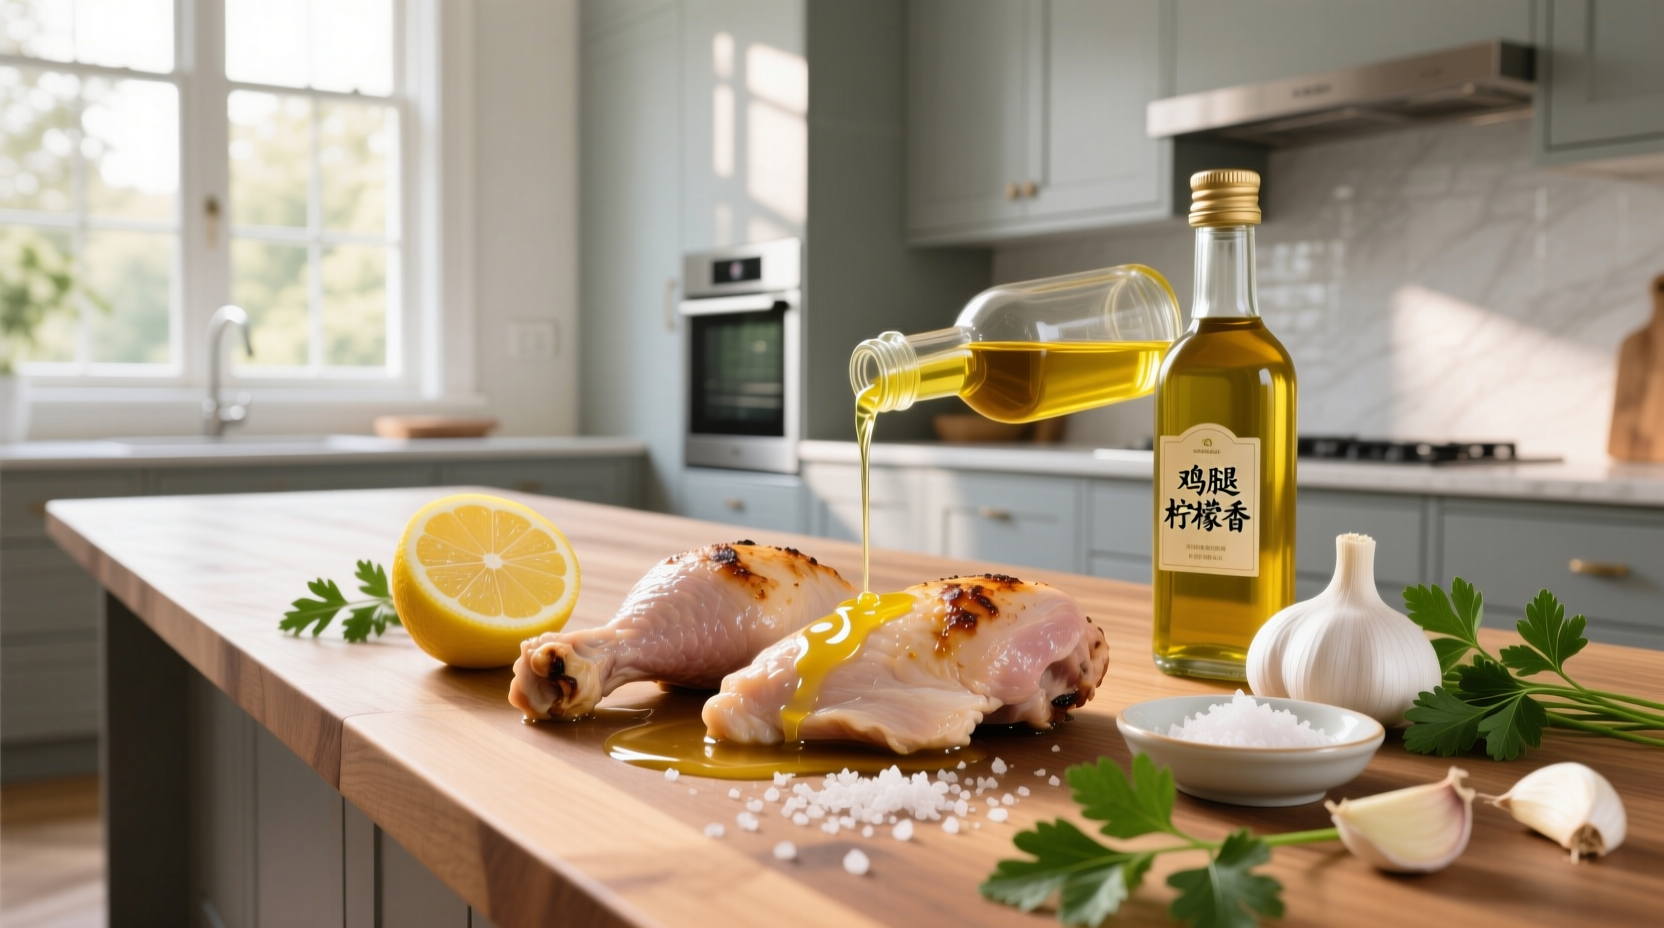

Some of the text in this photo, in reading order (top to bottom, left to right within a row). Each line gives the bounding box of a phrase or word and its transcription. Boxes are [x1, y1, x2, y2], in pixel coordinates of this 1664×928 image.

[1177, 464, 1241, 497] 鸡腿
[1163, 498, 1251, 533] 柠檬香
